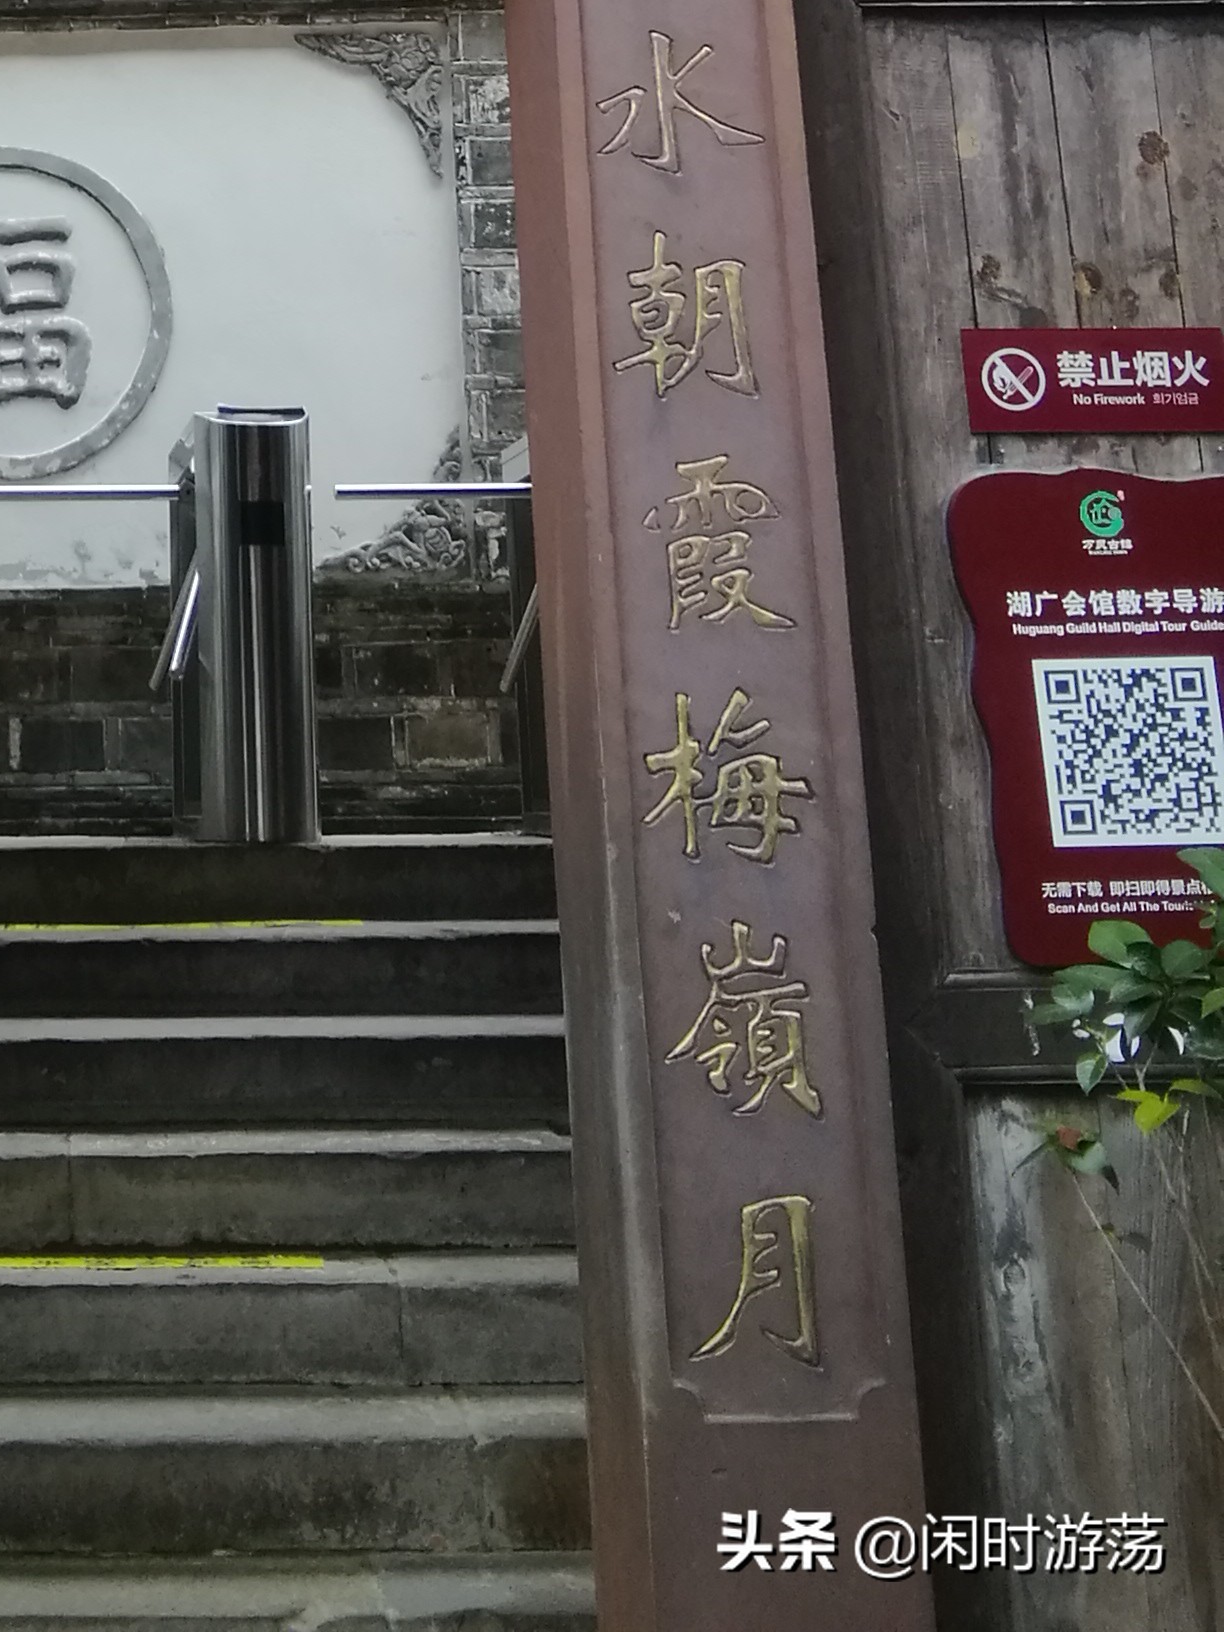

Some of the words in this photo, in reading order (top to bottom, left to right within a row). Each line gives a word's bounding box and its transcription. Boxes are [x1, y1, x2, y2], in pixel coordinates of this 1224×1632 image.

[1057, 349, 1210, 388] 禁止烟火
[1073, 393, 1091, 405] No
[1094, 392, 1146, 406] Firework
[1006, 587, 1224, 617] 湖广会馆数字导游
[1012, 623, 1065, 636] Huguang
[1066, 622, 1097, 634] Guild
[1099, 621, 1121, 633] Hall
[1123, 621, 1159, 635] Digital
[1160, 620, 1187, 632] Tour
[1042, 881, 1103, 899] 无需下载
[1048, 902, 1075, 914] Scan
[1077, 901, 1099, 913] And
[1101, 901, 1120, 913] Get
[1122, 901, 1137, 912] All
[1138, 901, 1160, 912] The
